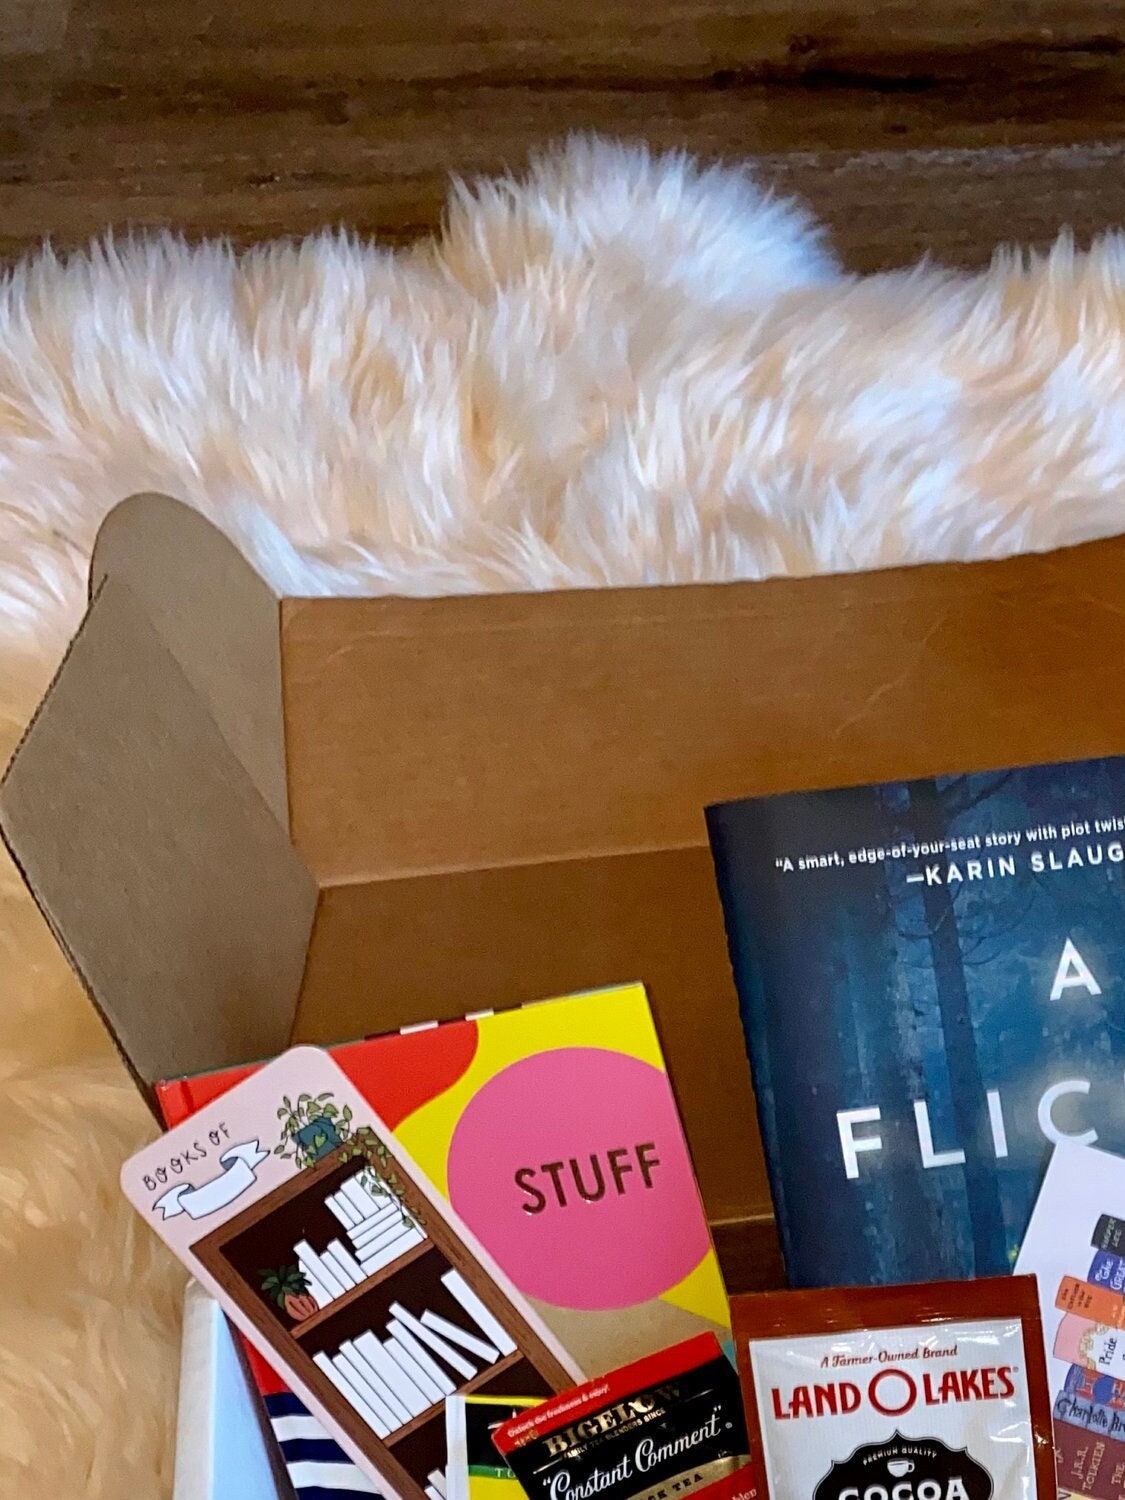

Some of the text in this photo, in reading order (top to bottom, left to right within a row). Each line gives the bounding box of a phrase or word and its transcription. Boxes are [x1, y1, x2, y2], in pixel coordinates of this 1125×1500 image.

[798, 850, 845, 871] smart,
[848, 834, 981, 864] edge-of-your-seat
[985, 829, 1021, 848] story
[1025, 823, 1057, 842] with
[1062, 821, 1090, 840] plot
[1049, 938, 1102, 1001] A
[143, 1122, 231, 1191] BOOKS OF
[514, 1143, 661, 1216] STUFF
[820, 1344, 958, 1369] A Farmer-Owned Brand
[1098, 1337, 1117, 1366] Pride
[643, 1408, 666, 1423] SINCE
[771, 1366, 1016, 1421] LAND O LAKES
[541, 1381, 683, 1457] BIGELOW
[863, 1445, 937, 1466] PREMIUM QUALITY
[1082, 1441, 1105, 1490] TOLKIEN
[1111, 1463, 1125, 1485] THE
[672, 1473, 704, 1491] TEA
